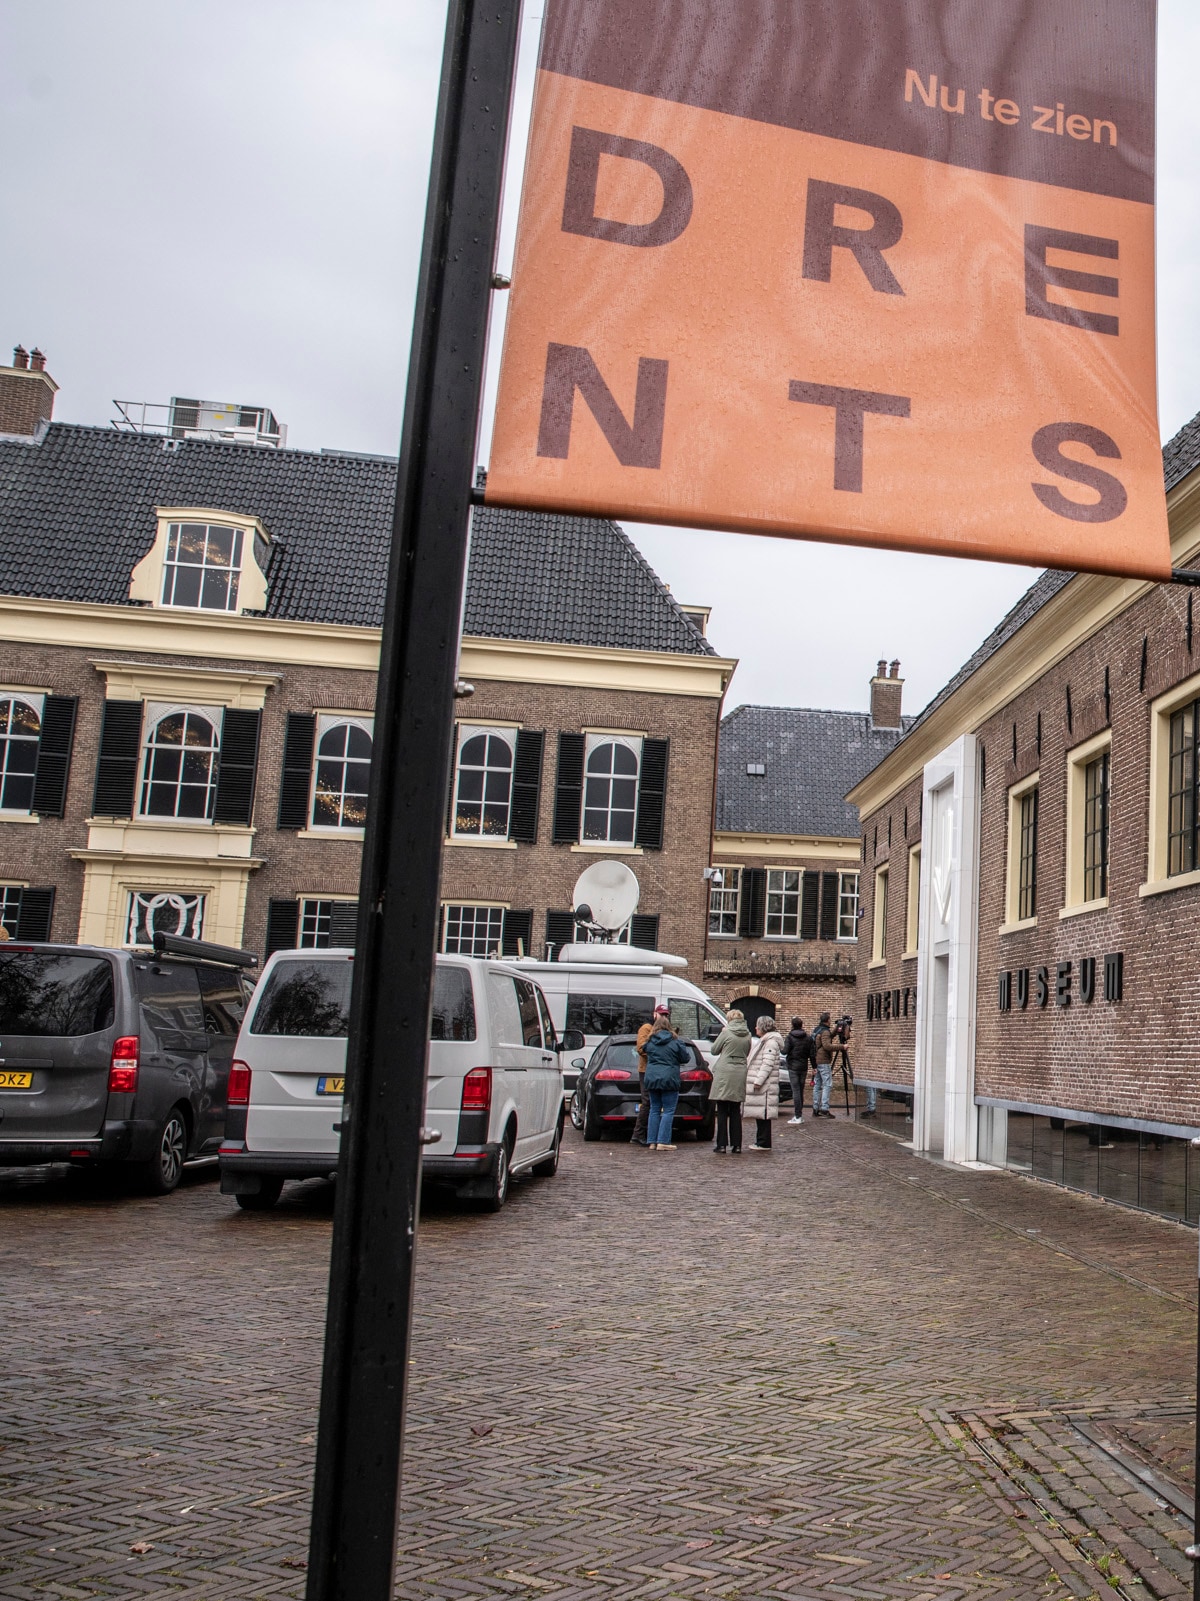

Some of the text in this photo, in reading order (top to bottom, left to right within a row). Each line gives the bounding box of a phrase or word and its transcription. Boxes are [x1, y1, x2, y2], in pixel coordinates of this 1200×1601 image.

[904, 68, 1118, 147] Nu te zien
[998, 952, 1124, 1012] MUSEUM
